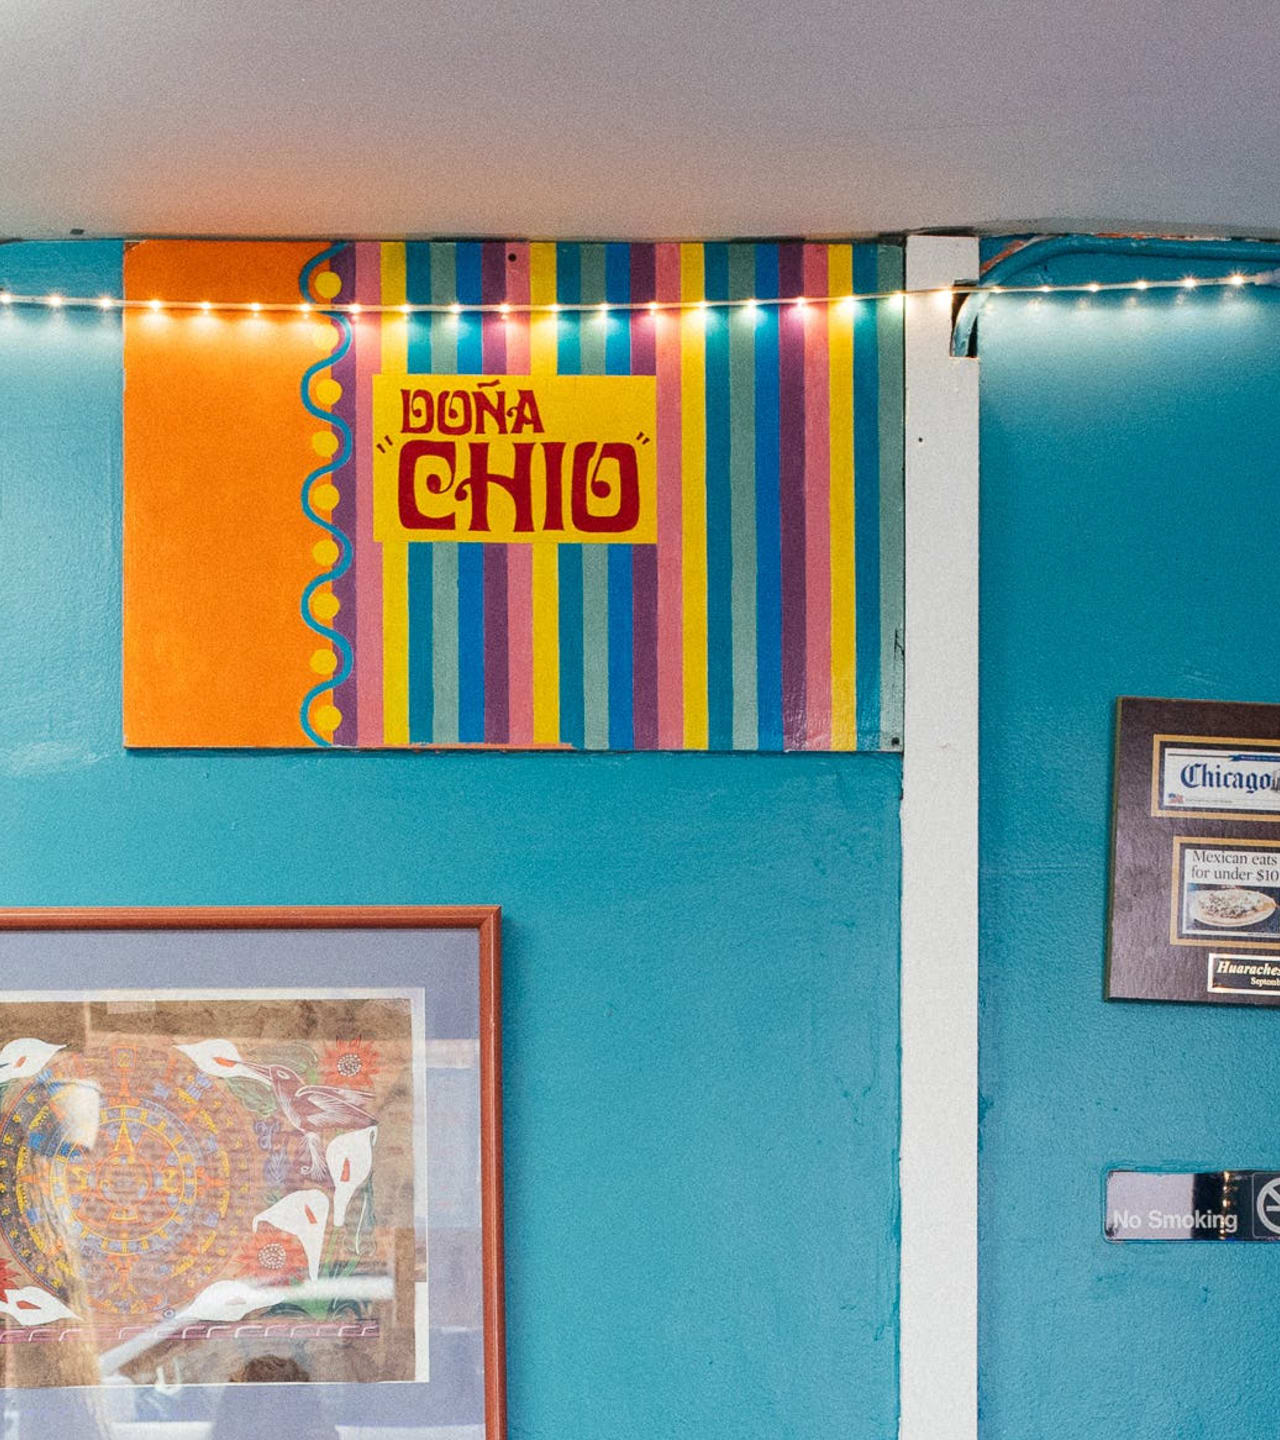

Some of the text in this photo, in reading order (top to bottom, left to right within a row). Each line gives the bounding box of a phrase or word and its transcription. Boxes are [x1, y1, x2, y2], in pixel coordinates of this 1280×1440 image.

[400, 379, 545, 435] DOÑA
[1180, 763, 1272, 794] Chicago
[1192, 850, 1278, 866] Mexican eats
[1191, 865, 1280, 881] for under $10
[1113, 1209, 1238, 1233] No Smoking
